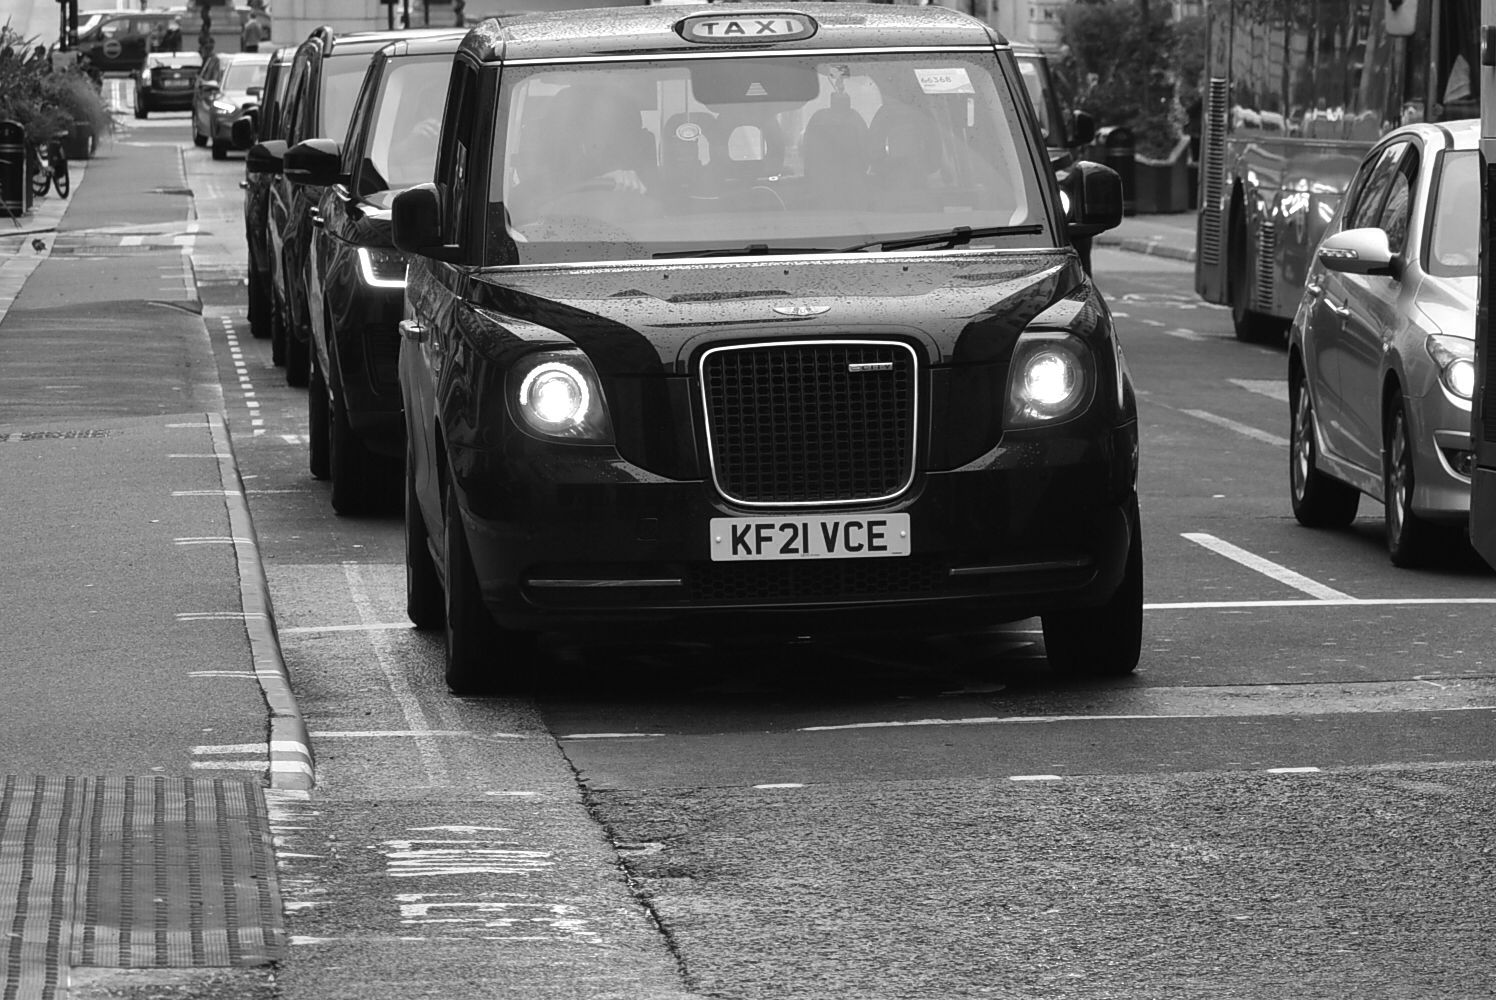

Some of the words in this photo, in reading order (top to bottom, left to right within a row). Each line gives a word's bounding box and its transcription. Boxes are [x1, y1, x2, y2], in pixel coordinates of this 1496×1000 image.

[701, 20, 794, 35] TAXI
[731, 523, 809, 556] KF21
[820, 520, 888, 553] VCE
